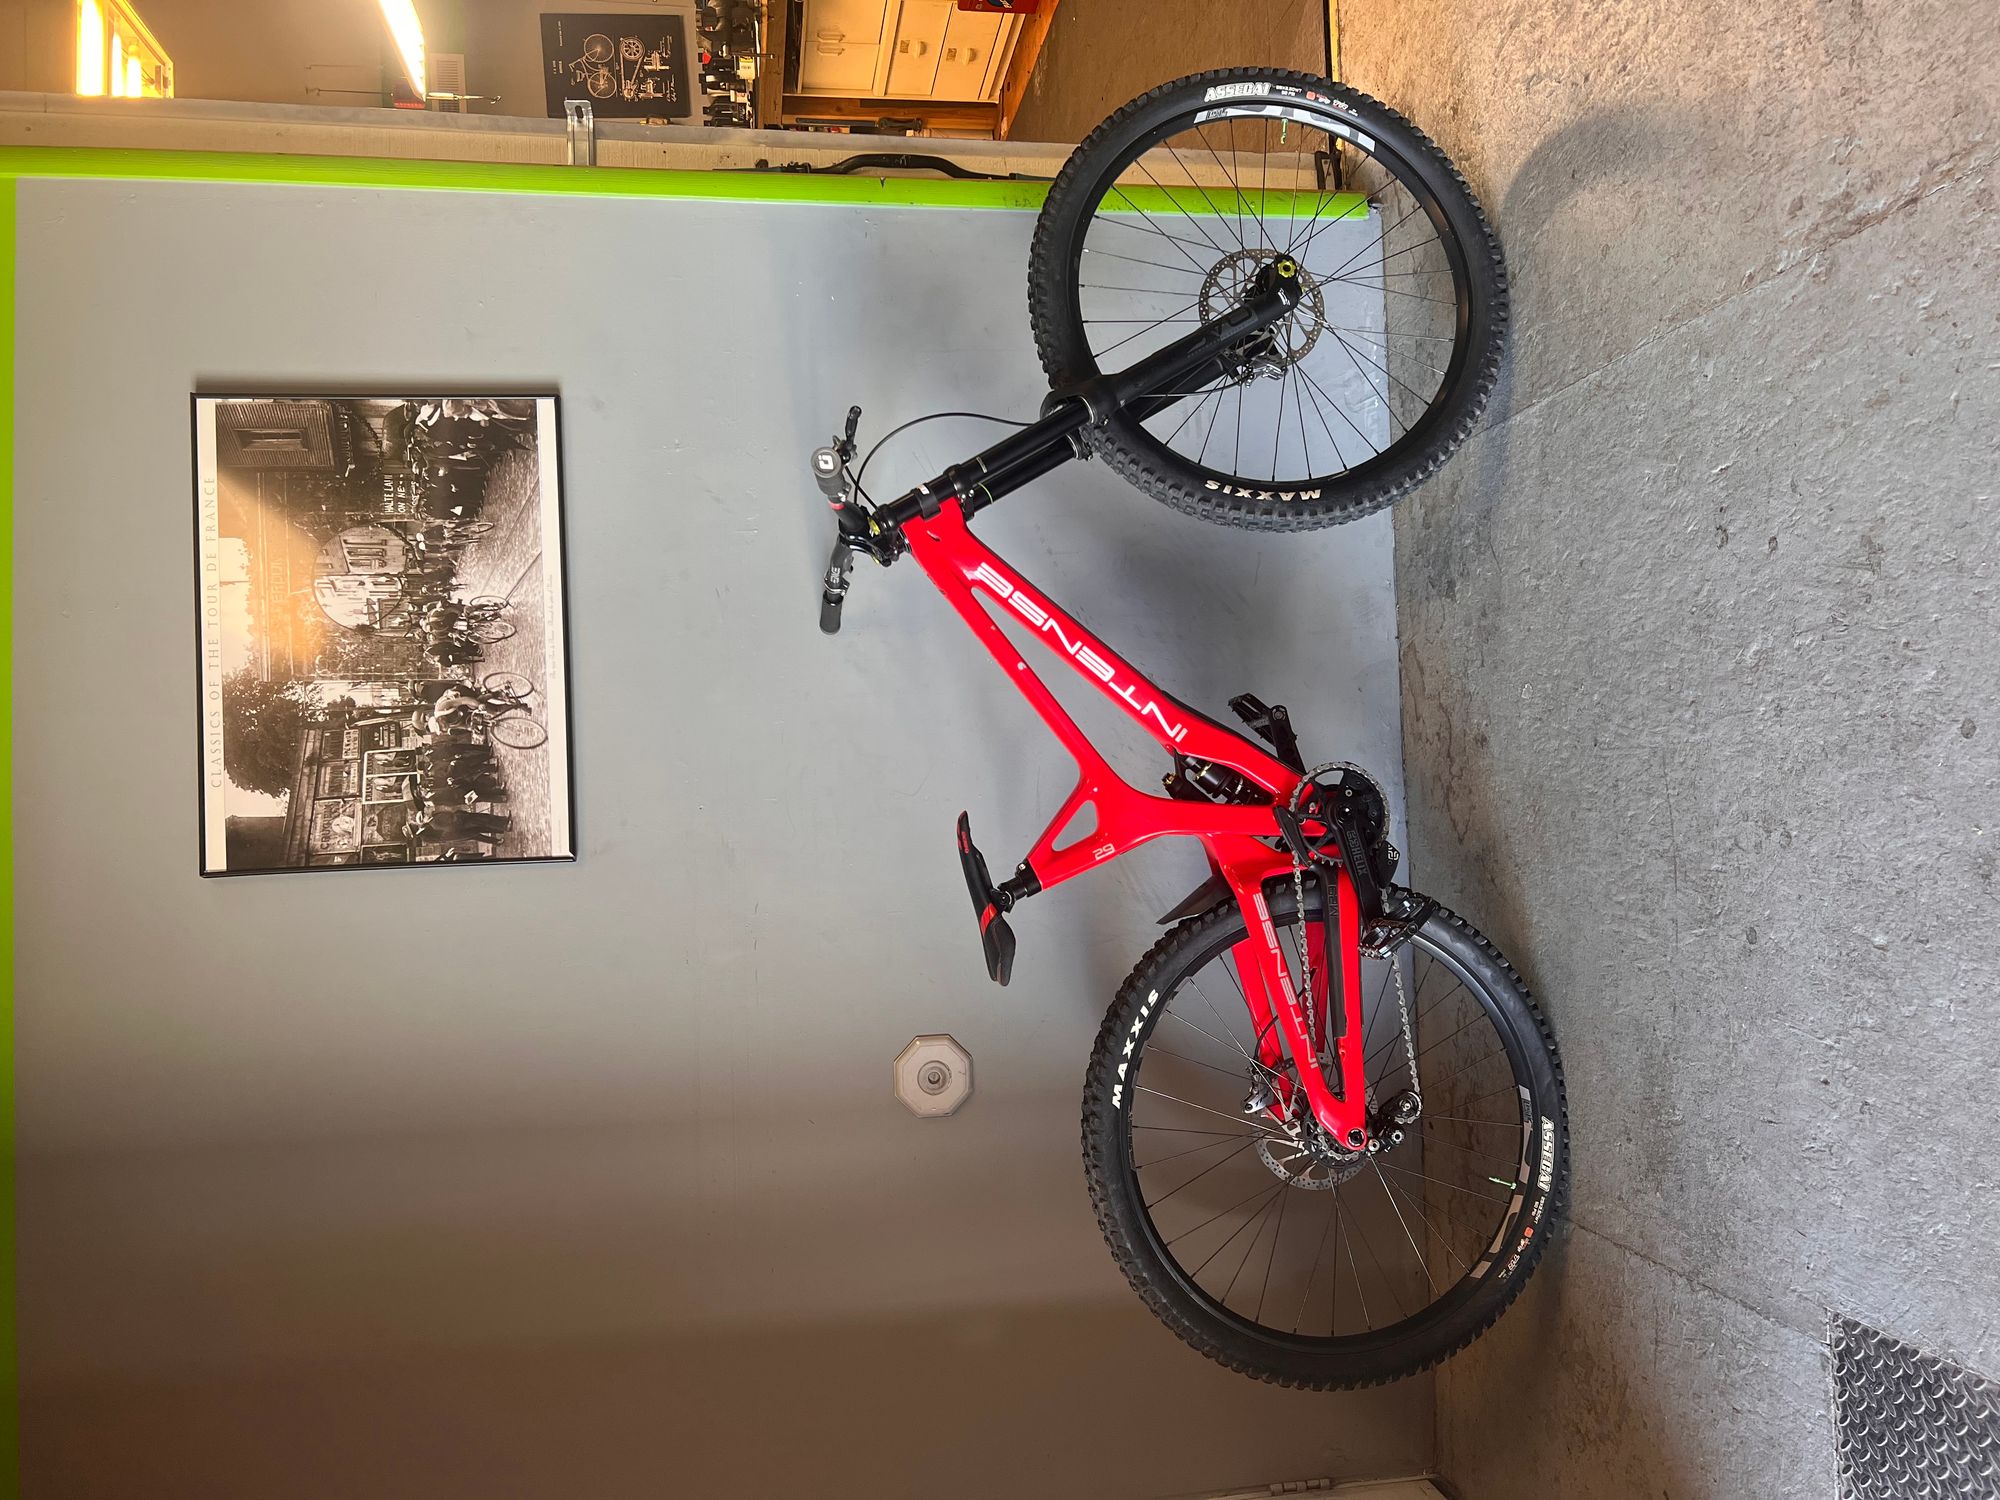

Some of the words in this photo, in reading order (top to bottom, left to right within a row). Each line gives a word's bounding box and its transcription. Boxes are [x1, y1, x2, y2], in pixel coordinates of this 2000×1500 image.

[1203, 81, 1272, 103] ASSEGAI
[384, 493, 394, 513] HALTE
[1203, 479, 1322, 502] MAXXIS
[204, 477, 216, 542] FRANCE
[398, 502, 406, 513] ON
[206, 552, 218, 572] DE
[206, 583, 219, 628] TOUR
[208, 638, 220, 669] THE
[972, 561, 1189, 743] INTENSE
[208, 680, 220, 700] OF
[209, 710, 222, 788] CLASSICS
[1092, 842, 1116, 861] 29
[1352, 846, 1368, 876] HELIX
[1252, 892, 1319, 1069] INTENSE
[1111, 988, 1160, 1110] MAXXIS
[1536, 1114, 1555, 1192] ASSEGAI
